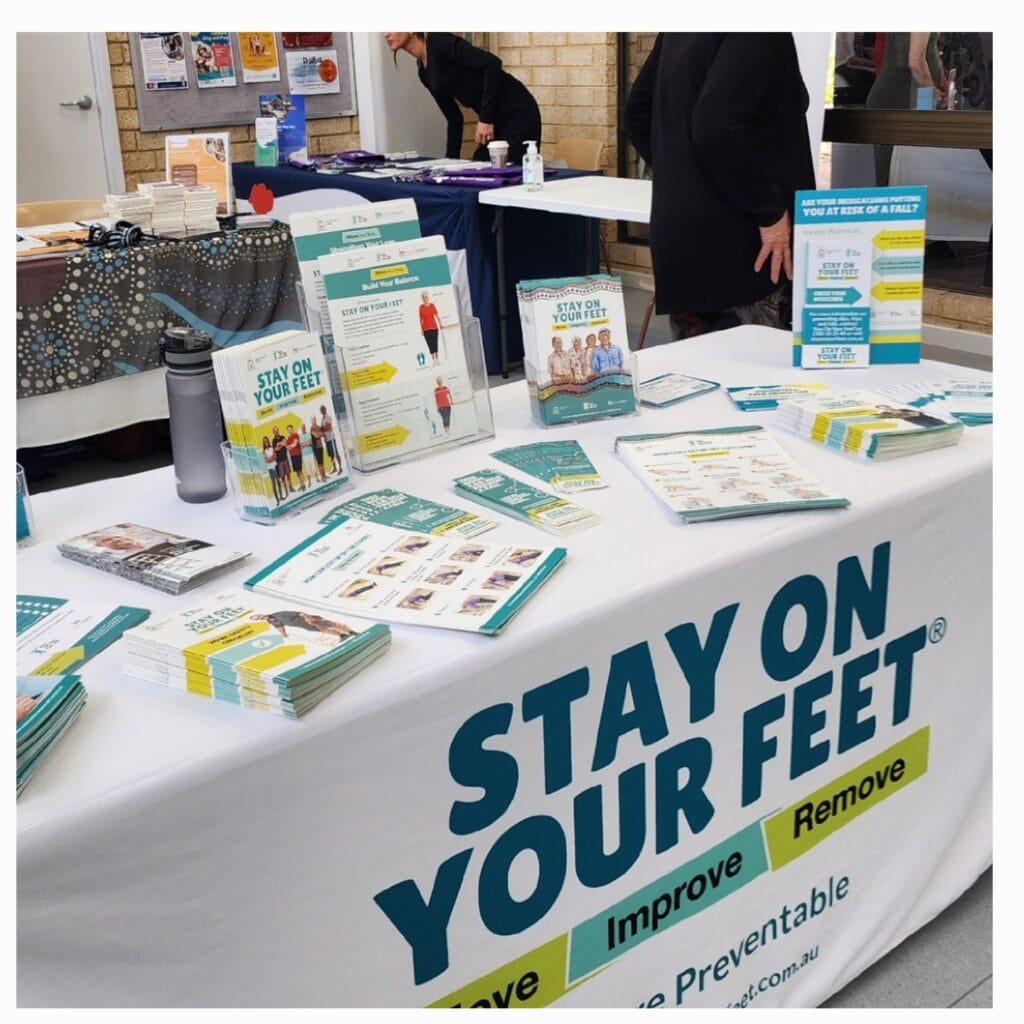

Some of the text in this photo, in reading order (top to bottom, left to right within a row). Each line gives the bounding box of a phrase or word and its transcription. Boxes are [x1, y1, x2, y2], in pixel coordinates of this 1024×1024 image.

[803, 204, 919, 216] YOU AT RISK OF A FALL?
[816, 198, 836, 206] YOUR
[362, 276, 419, 291] Build Your Balance
[341, 305, 357, 316] STAY
[359, 304, 369, 313] ON
[370, 301, 388, 311] YOUR
[552, 308, 608, 323] YOUR FEET
[557, 299, 601, 313] STAY ON
[257, 358, 312, 389] STAY ON
[254, 371, 321, 407] YOUR FEET
[448, 541, 891, 836] STAY ON
[373, 736, 715, 986] YOUR
[607, 850, 744, 951] Improve
[792, 754, 906, 839] Remove
[675, 874, 851, 1006] Preventable
